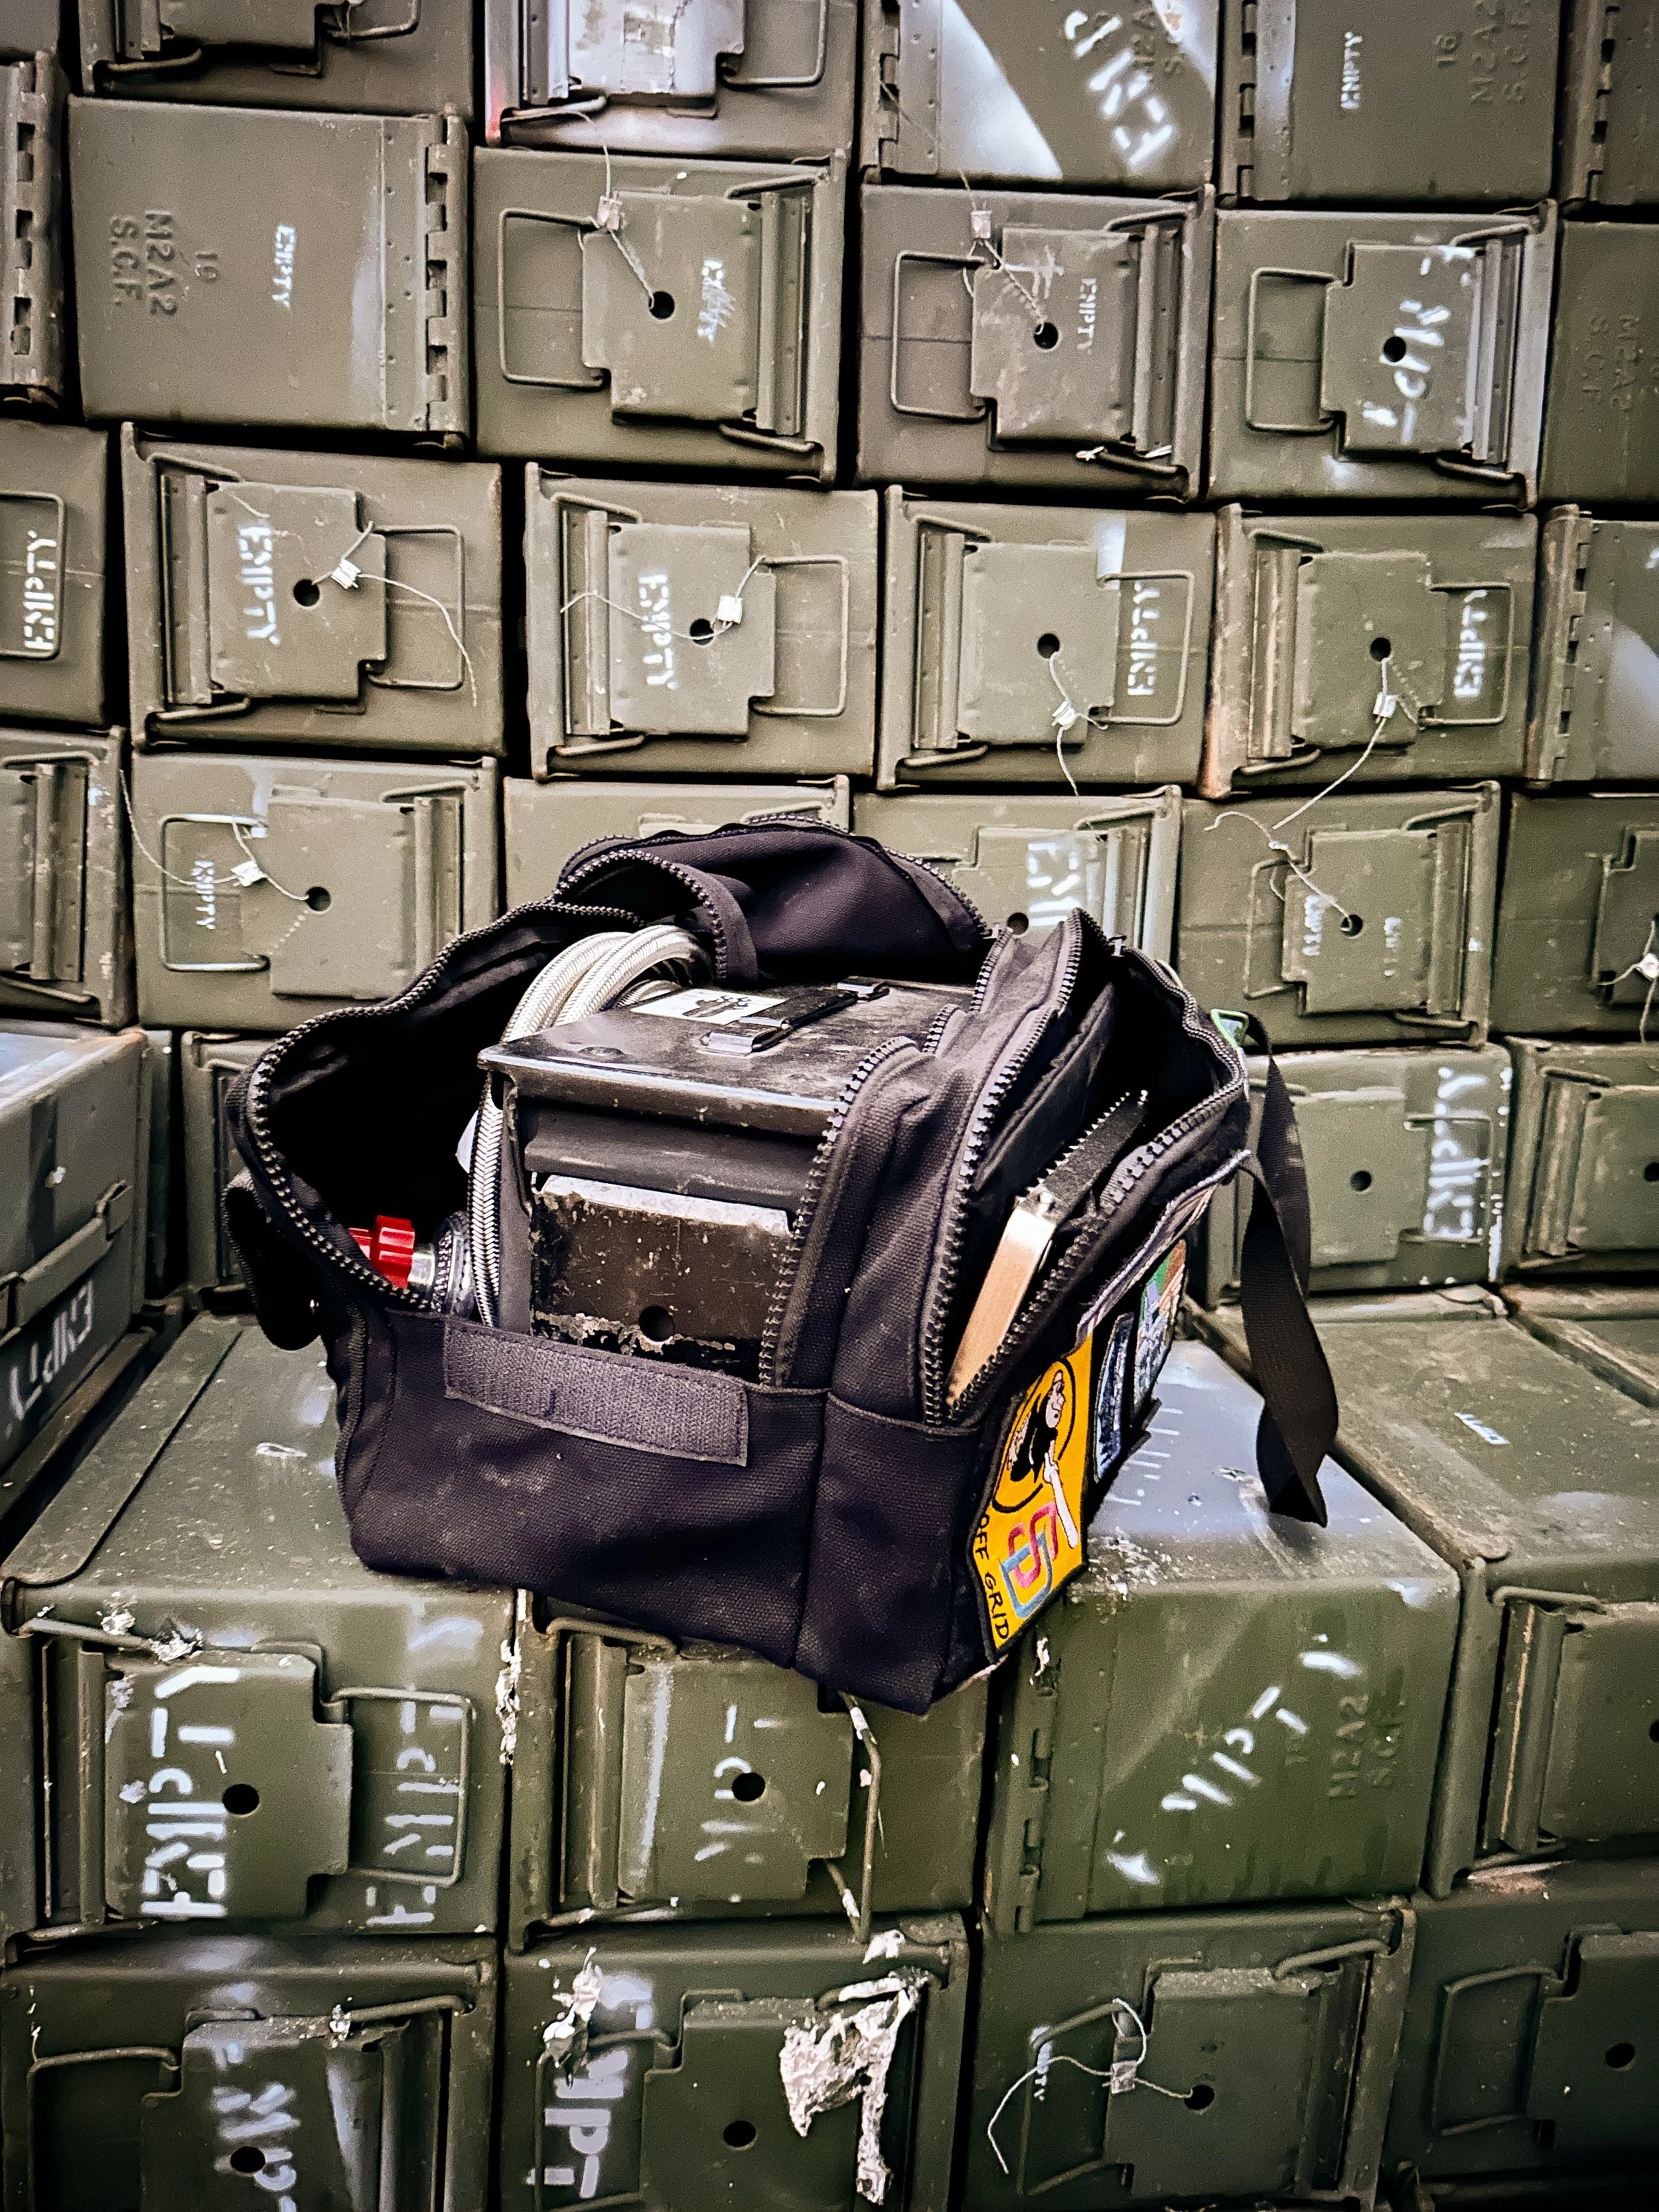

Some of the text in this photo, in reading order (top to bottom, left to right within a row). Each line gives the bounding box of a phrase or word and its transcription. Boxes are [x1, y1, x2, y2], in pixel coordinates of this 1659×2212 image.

[144, 210, 178, 316] M2A2
[272, 224, 295, 308] EMPTY
[1077, 278, 1097, 351] EMPTY
[23, 530, 57, 650] EMPTY
[238, 523, 281, 645] EMPTY
[638, 572, 679, 690] EMPTY
[1127, 582, 1160, 696] EMPTY
[1453, 589, 1487, 697] EMPTY
[191, 860, 216, 929] EMPTY
[1423, 1066, 1490, 1240] EMPTY
[975, 1514, 1009, 1640] OFF GRID
[141, 1664, 242, 1918] EMPTY
